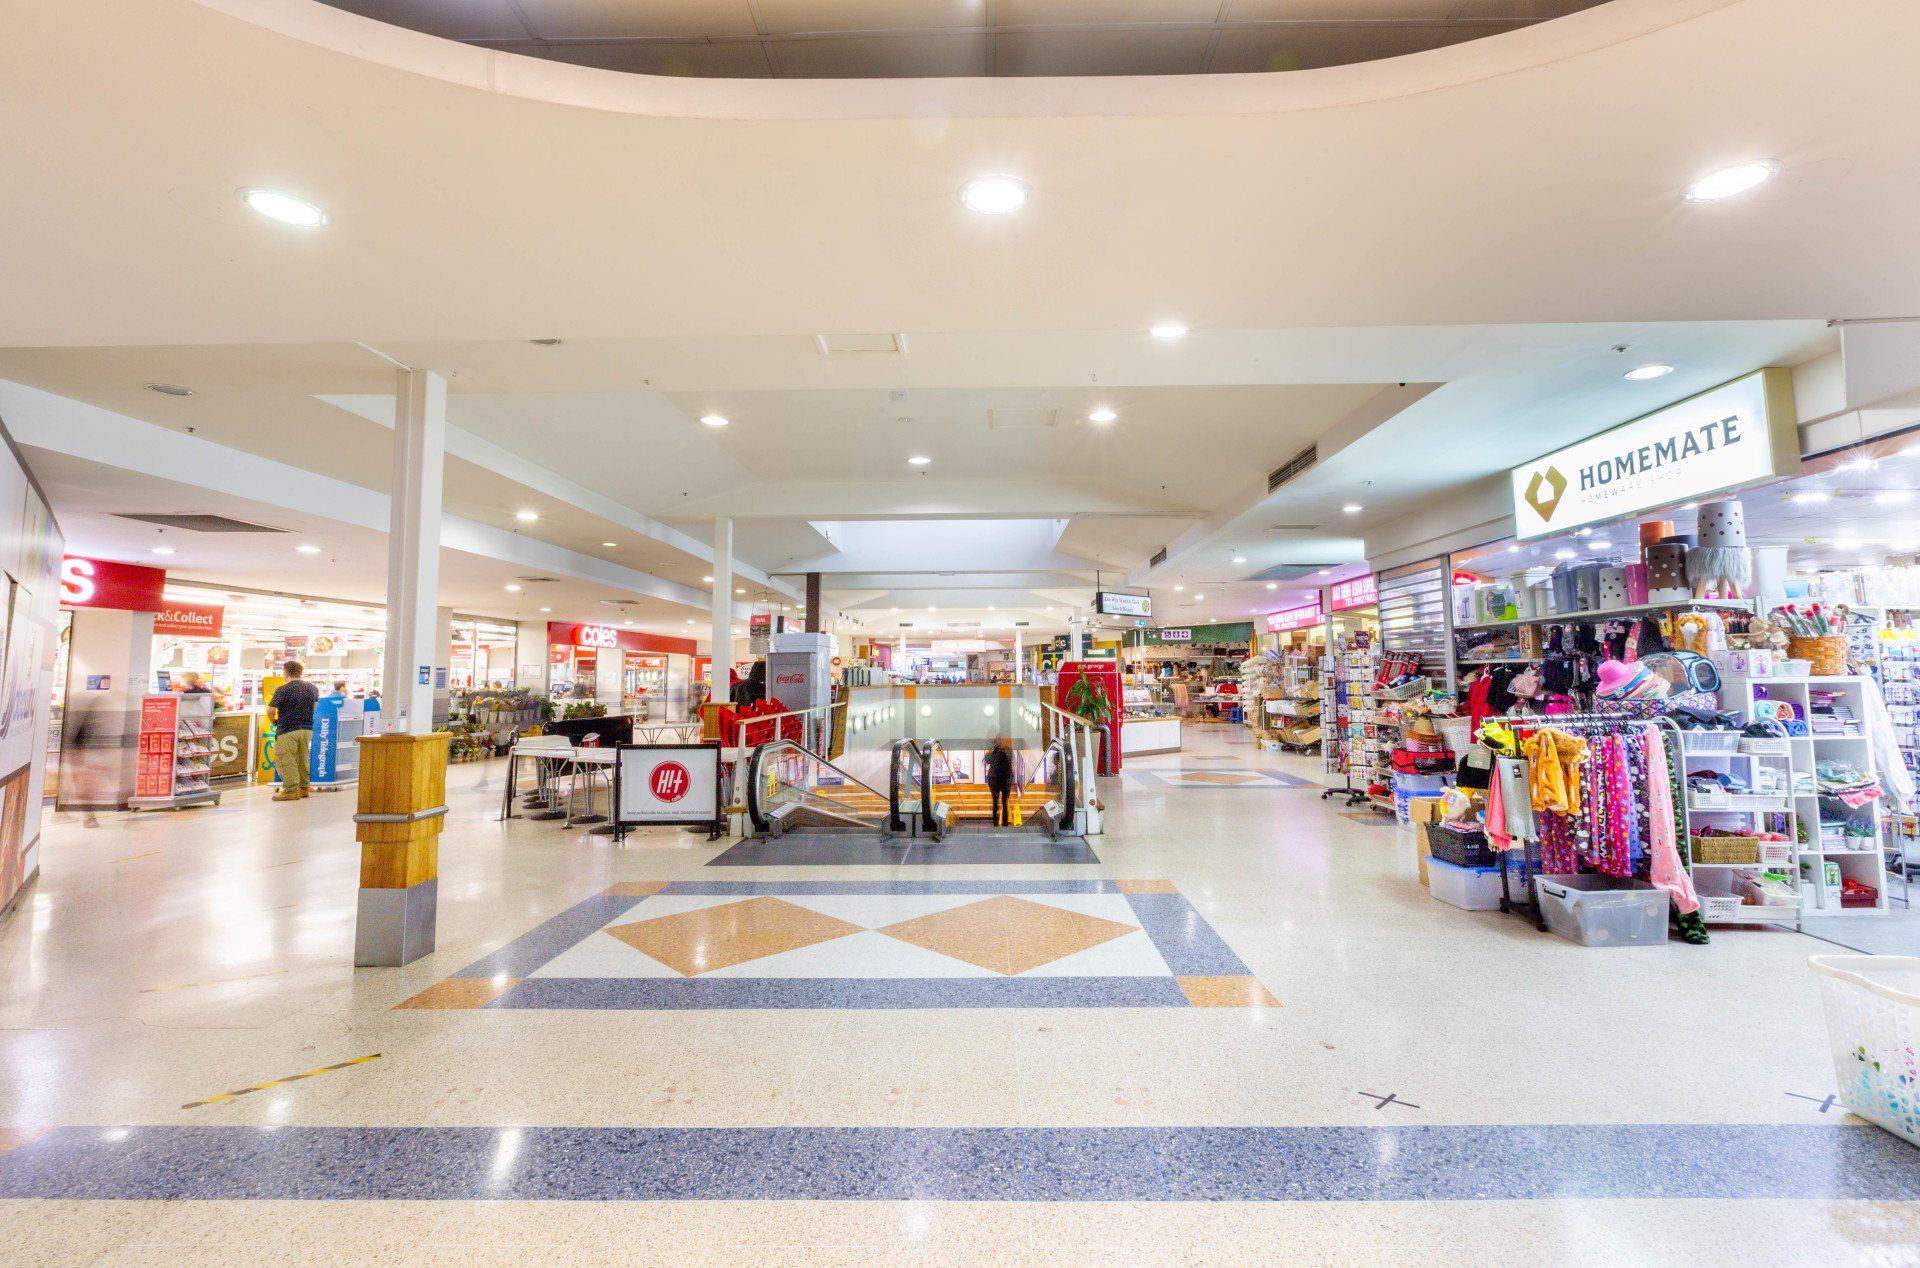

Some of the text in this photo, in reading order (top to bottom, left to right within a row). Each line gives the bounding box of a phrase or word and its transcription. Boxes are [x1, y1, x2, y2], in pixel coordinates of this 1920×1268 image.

[1579, 415, 1742, 491] HOMEMATE
[581, 626, 617, 648] coles
[776, 673, 804, 684] Coca-Cola
[317, 718, 330, 778] Daily Telegraph
